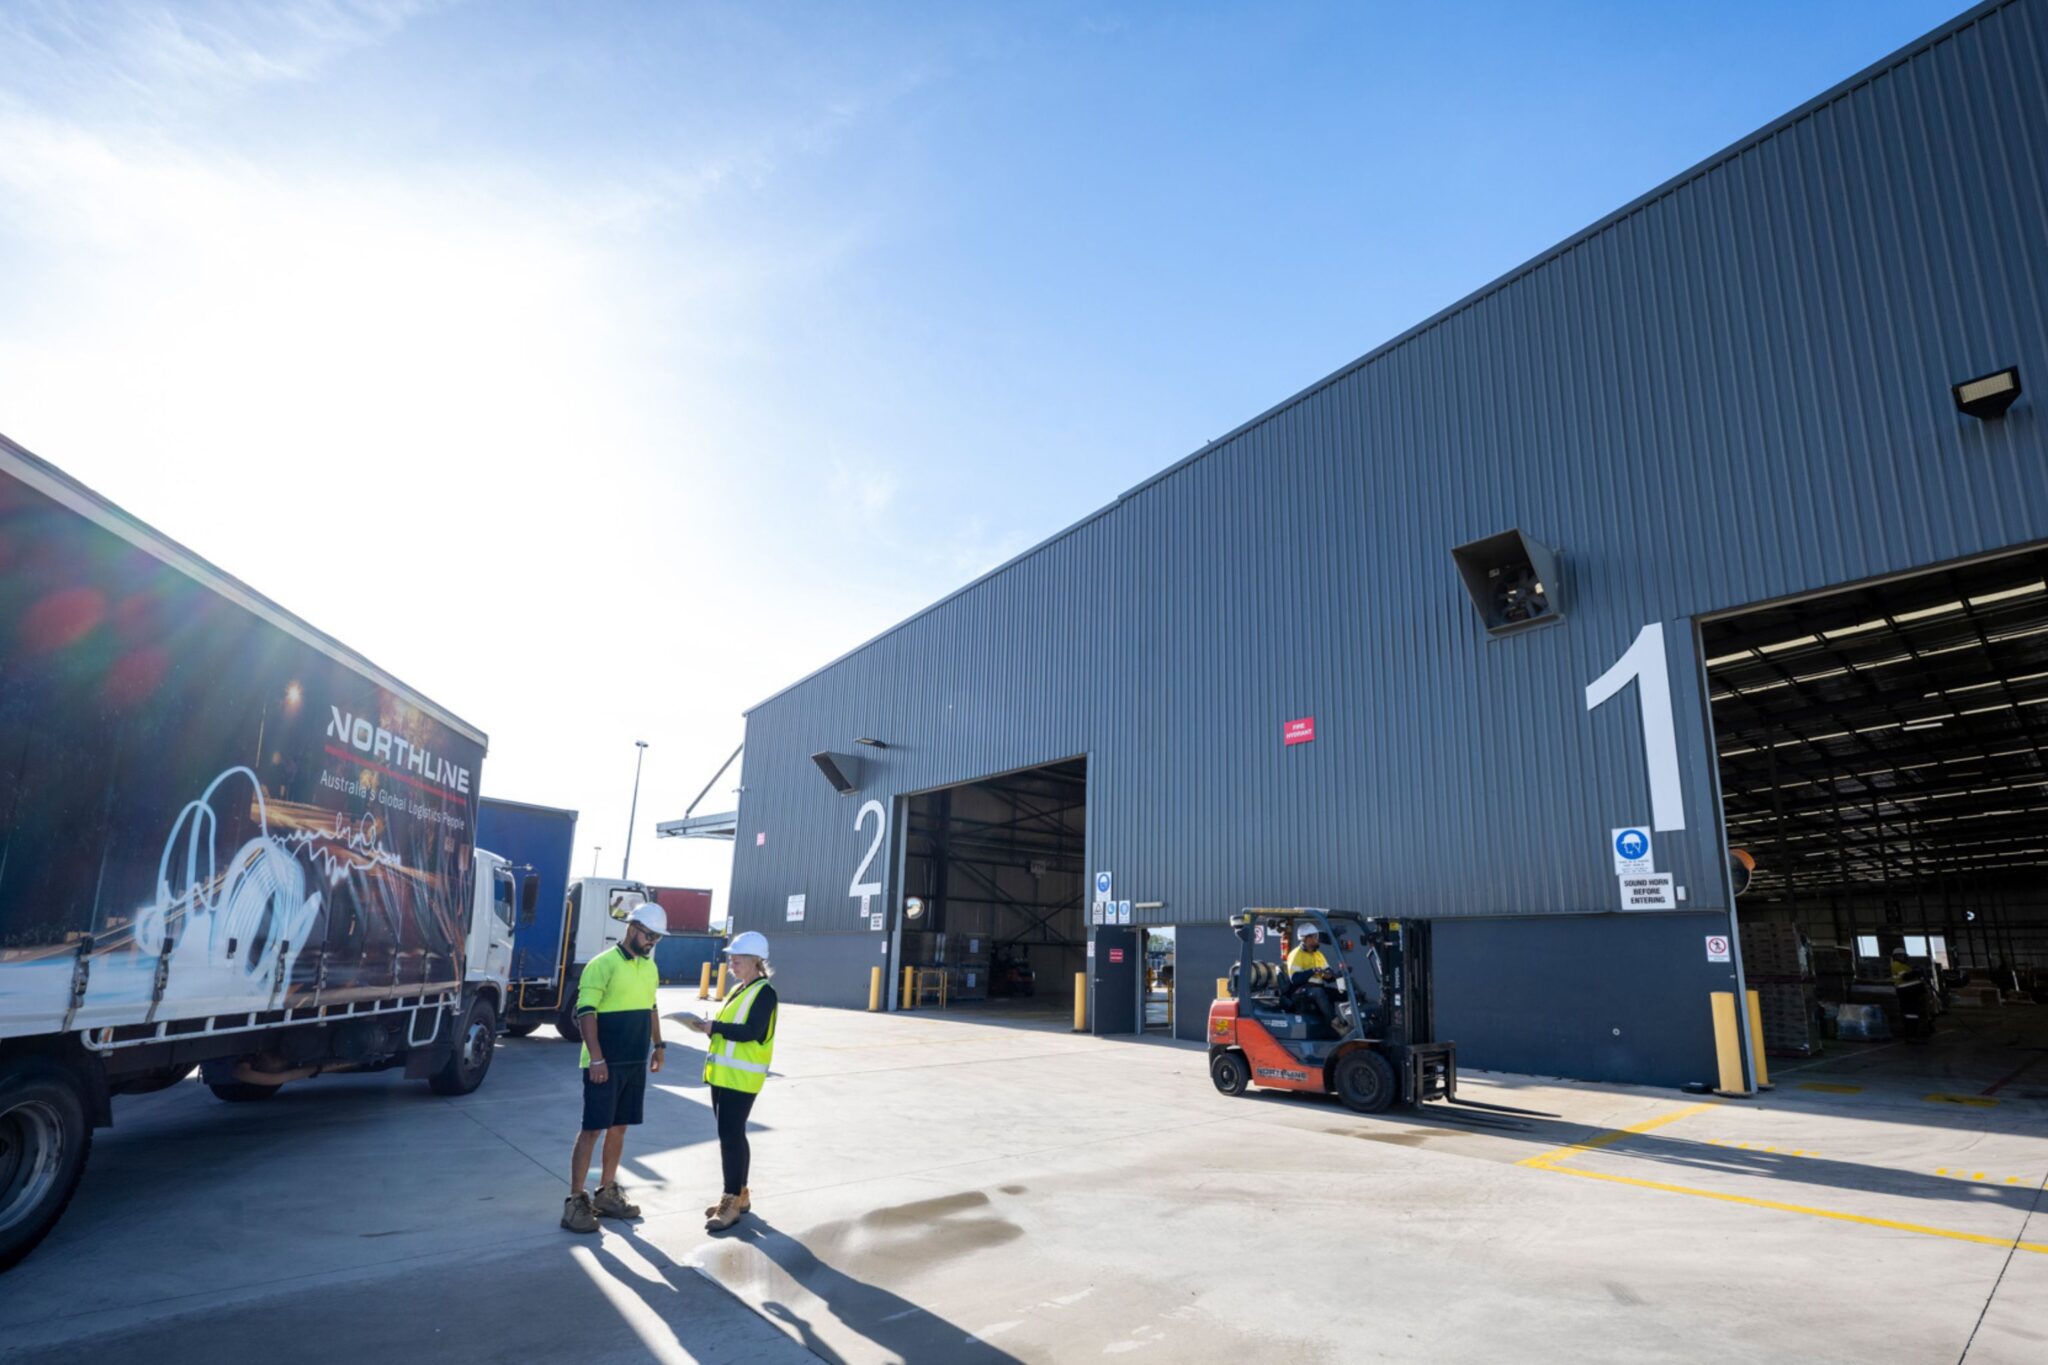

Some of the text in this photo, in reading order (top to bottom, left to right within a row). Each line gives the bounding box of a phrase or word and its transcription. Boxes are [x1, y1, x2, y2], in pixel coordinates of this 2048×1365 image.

[327, 705, 469, 794] NORTHLINE
[1586, 622, 1686, 832] 1
[320, 769, 464, 830] Australia's Global Logistics People
[849, 800, 885, 897] 2
[1624, 879, 1647, 887] SOUND
[1631, 896, 1666, 904] ENTERING
[1633, 887, 1661, 895] BEFORE
